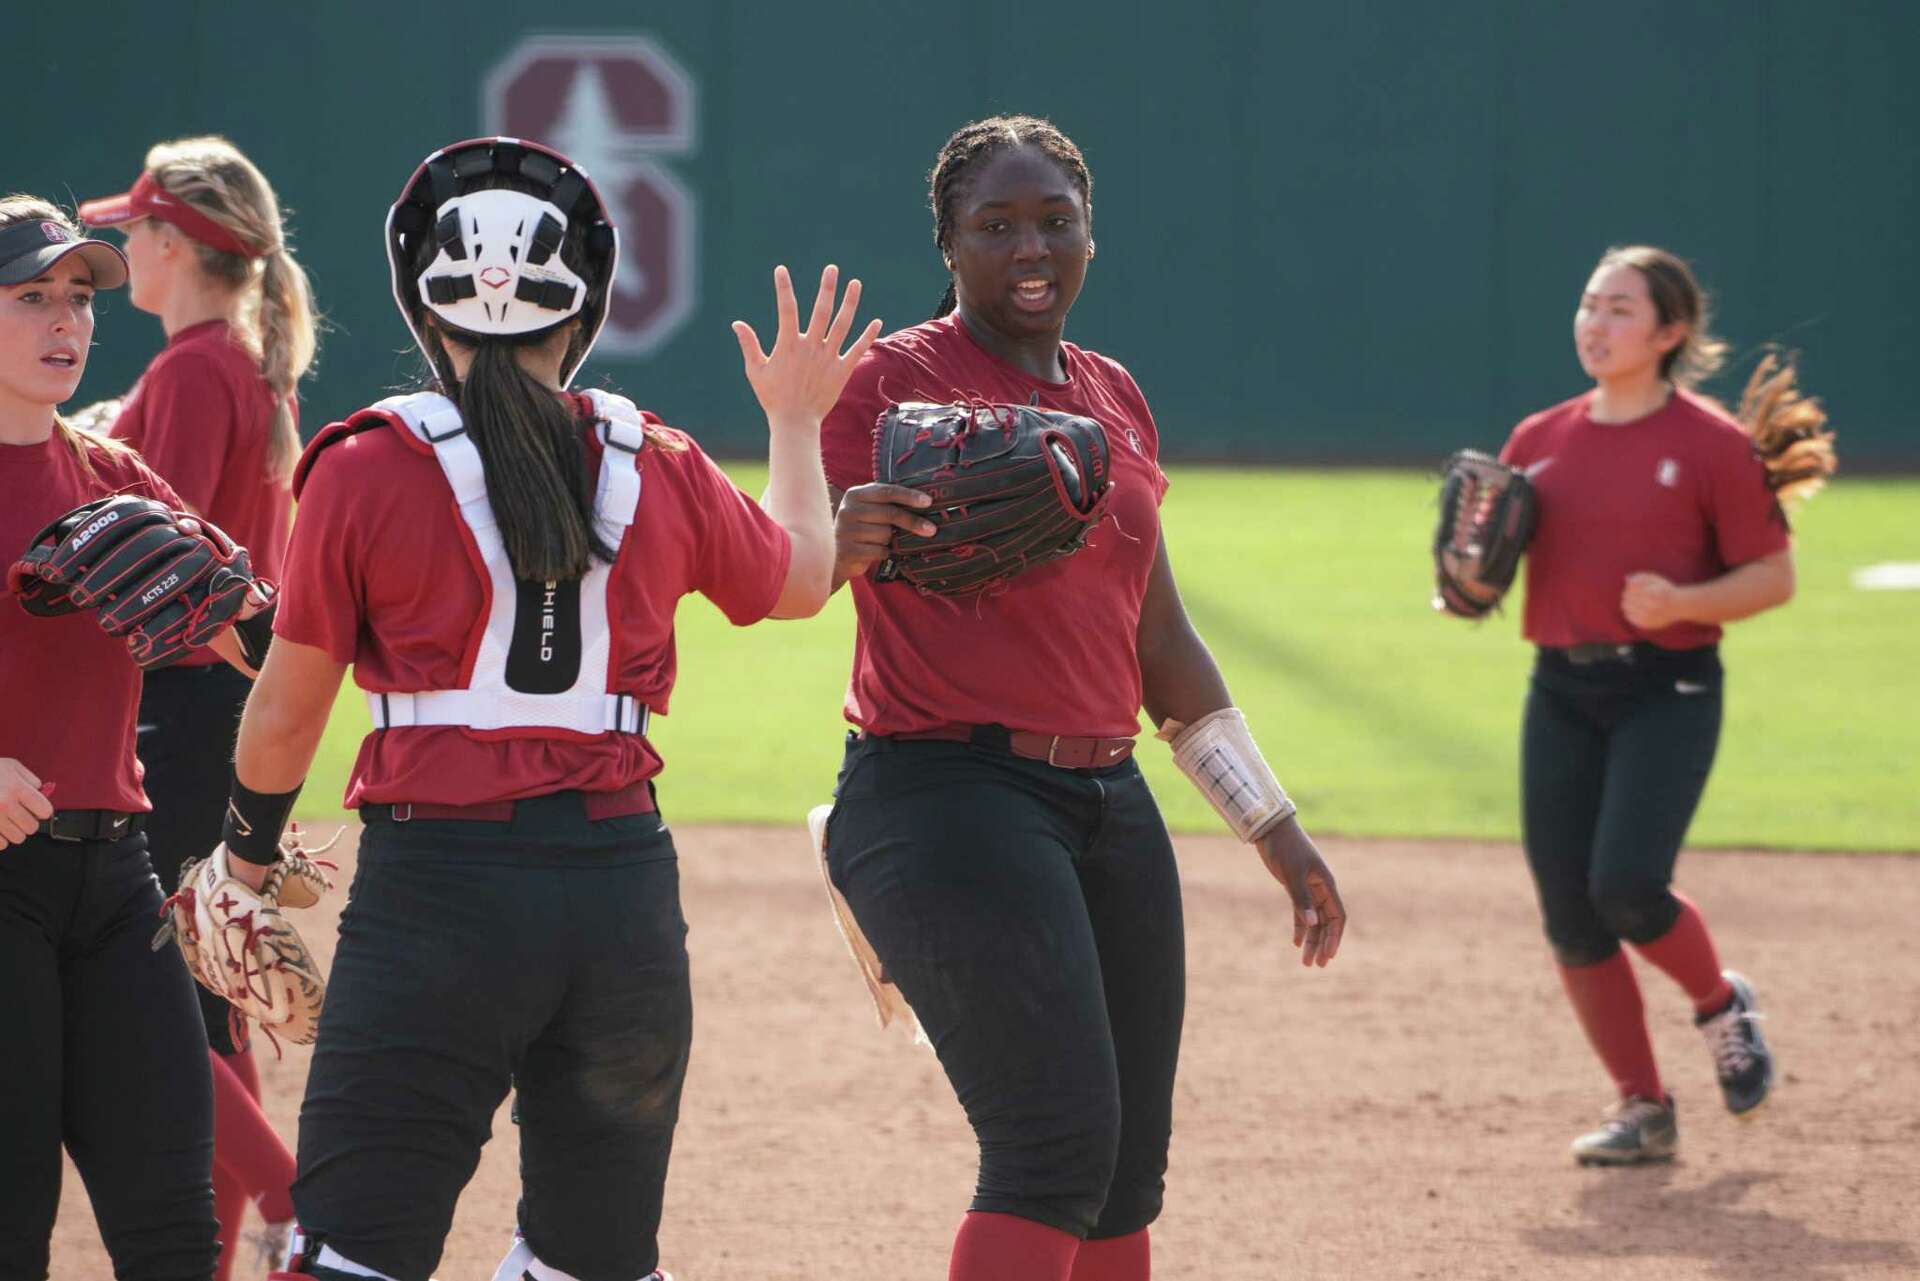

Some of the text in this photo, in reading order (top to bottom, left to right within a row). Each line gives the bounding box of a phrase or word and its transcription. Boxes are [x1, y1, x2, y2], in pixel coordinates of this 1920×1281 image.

[72, 511, 119, 551] A2000
[142, 574, 179, 604] ACTS 2:25
[541, 579, 557, 661] SHIELD
